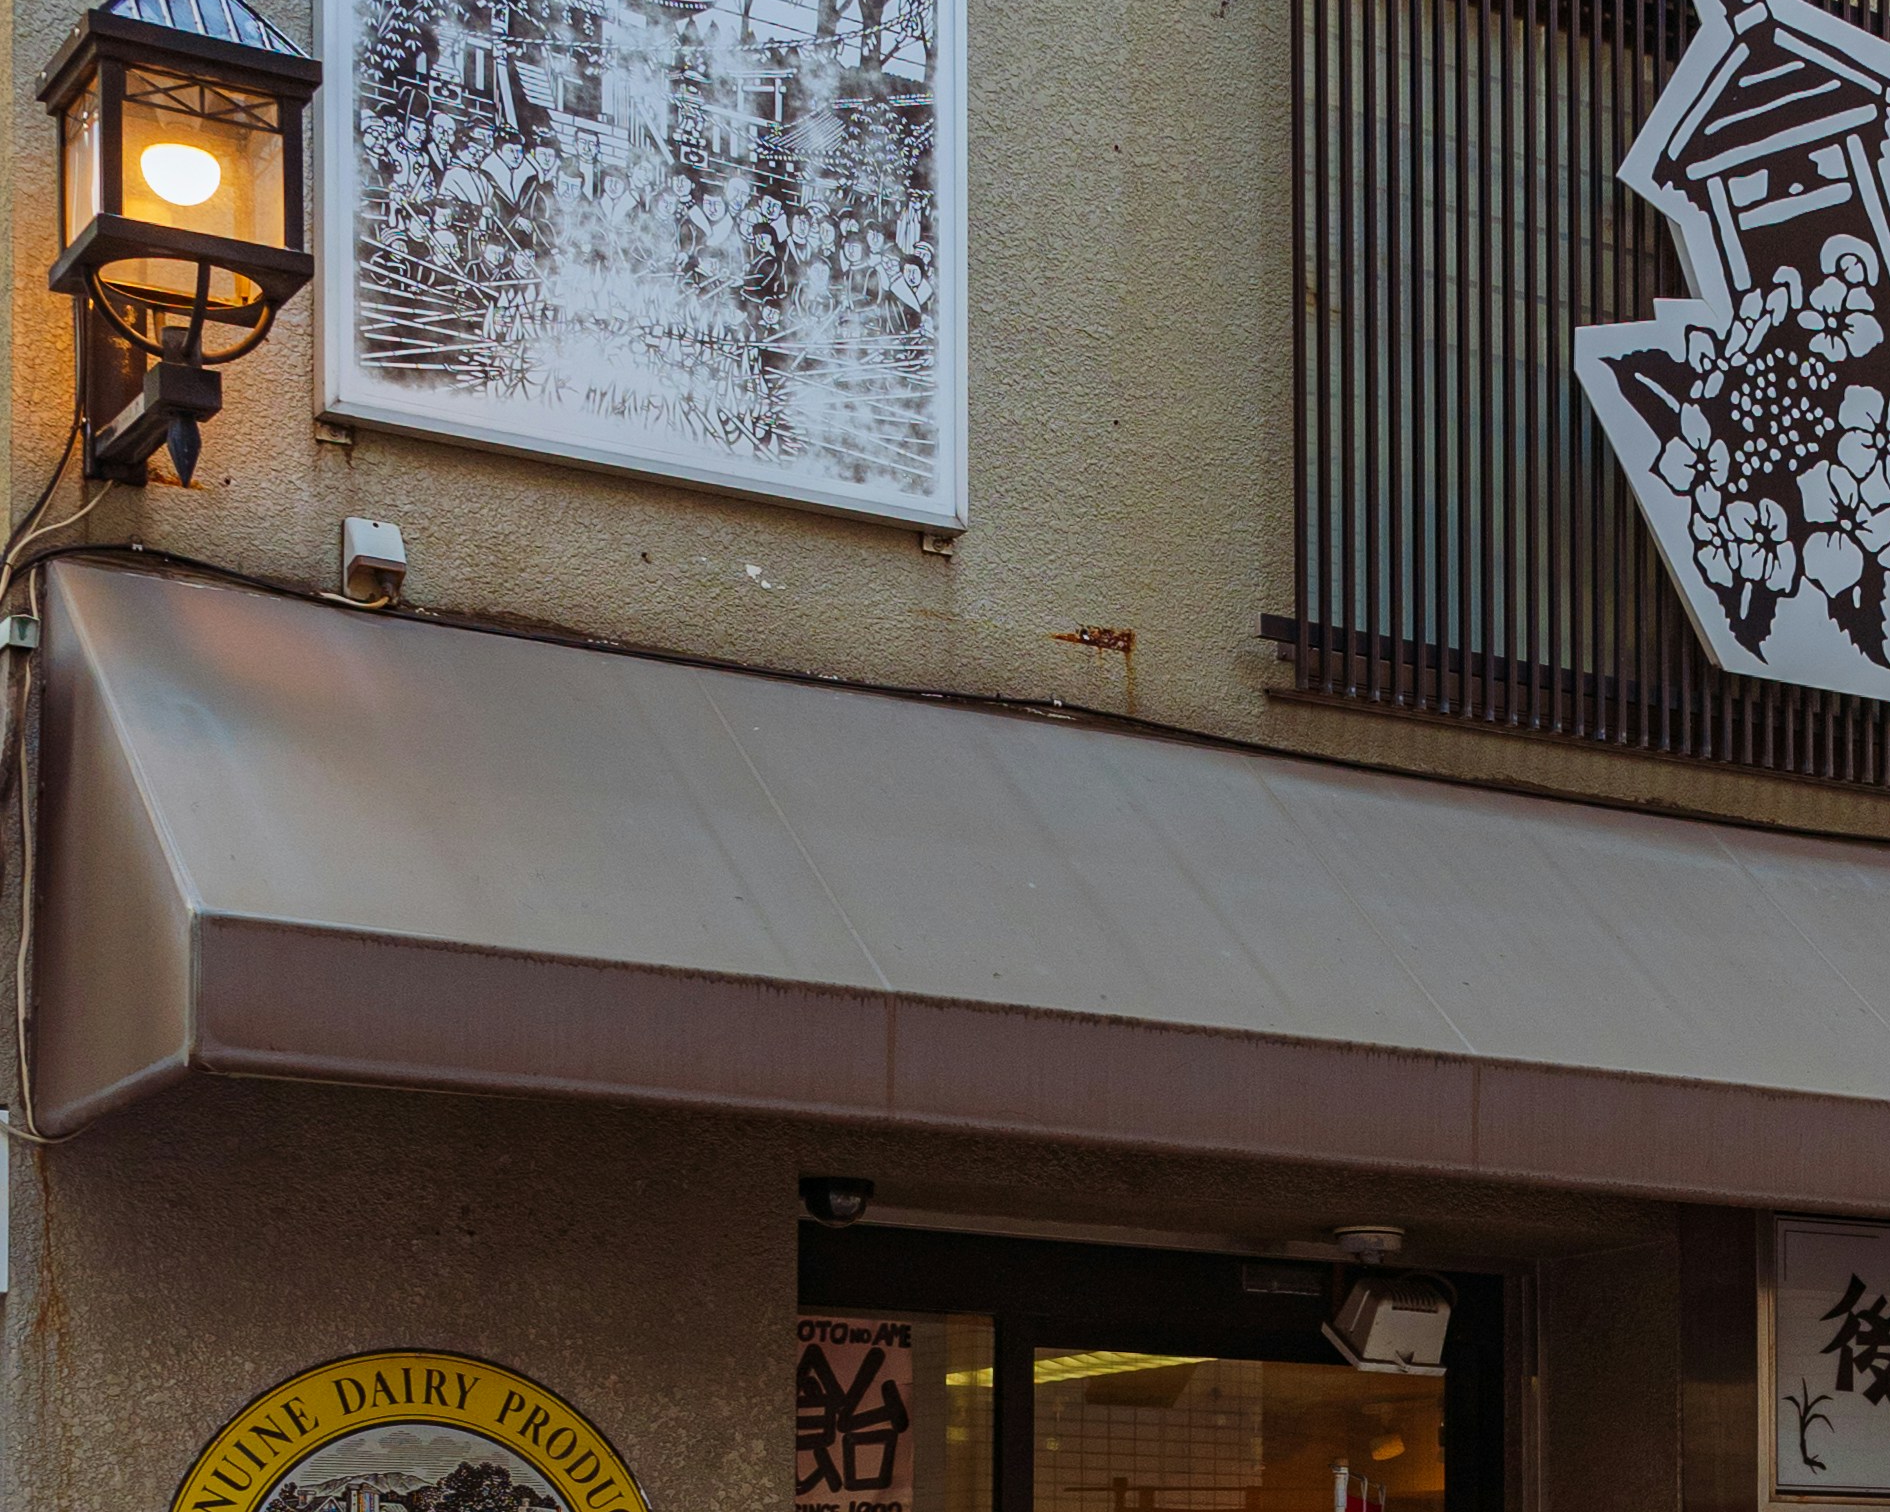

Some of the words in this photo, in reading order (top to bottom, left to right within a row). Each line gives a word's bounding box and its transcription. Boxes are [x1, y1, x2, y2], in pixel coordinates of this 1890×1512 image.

[797, 1320, 848, 1345] OTO
[872, 1322, 911, 1347] AME
[332, 1366, 482, 1417] DAIRY
[795, 1343, 909, 1494] 飴
